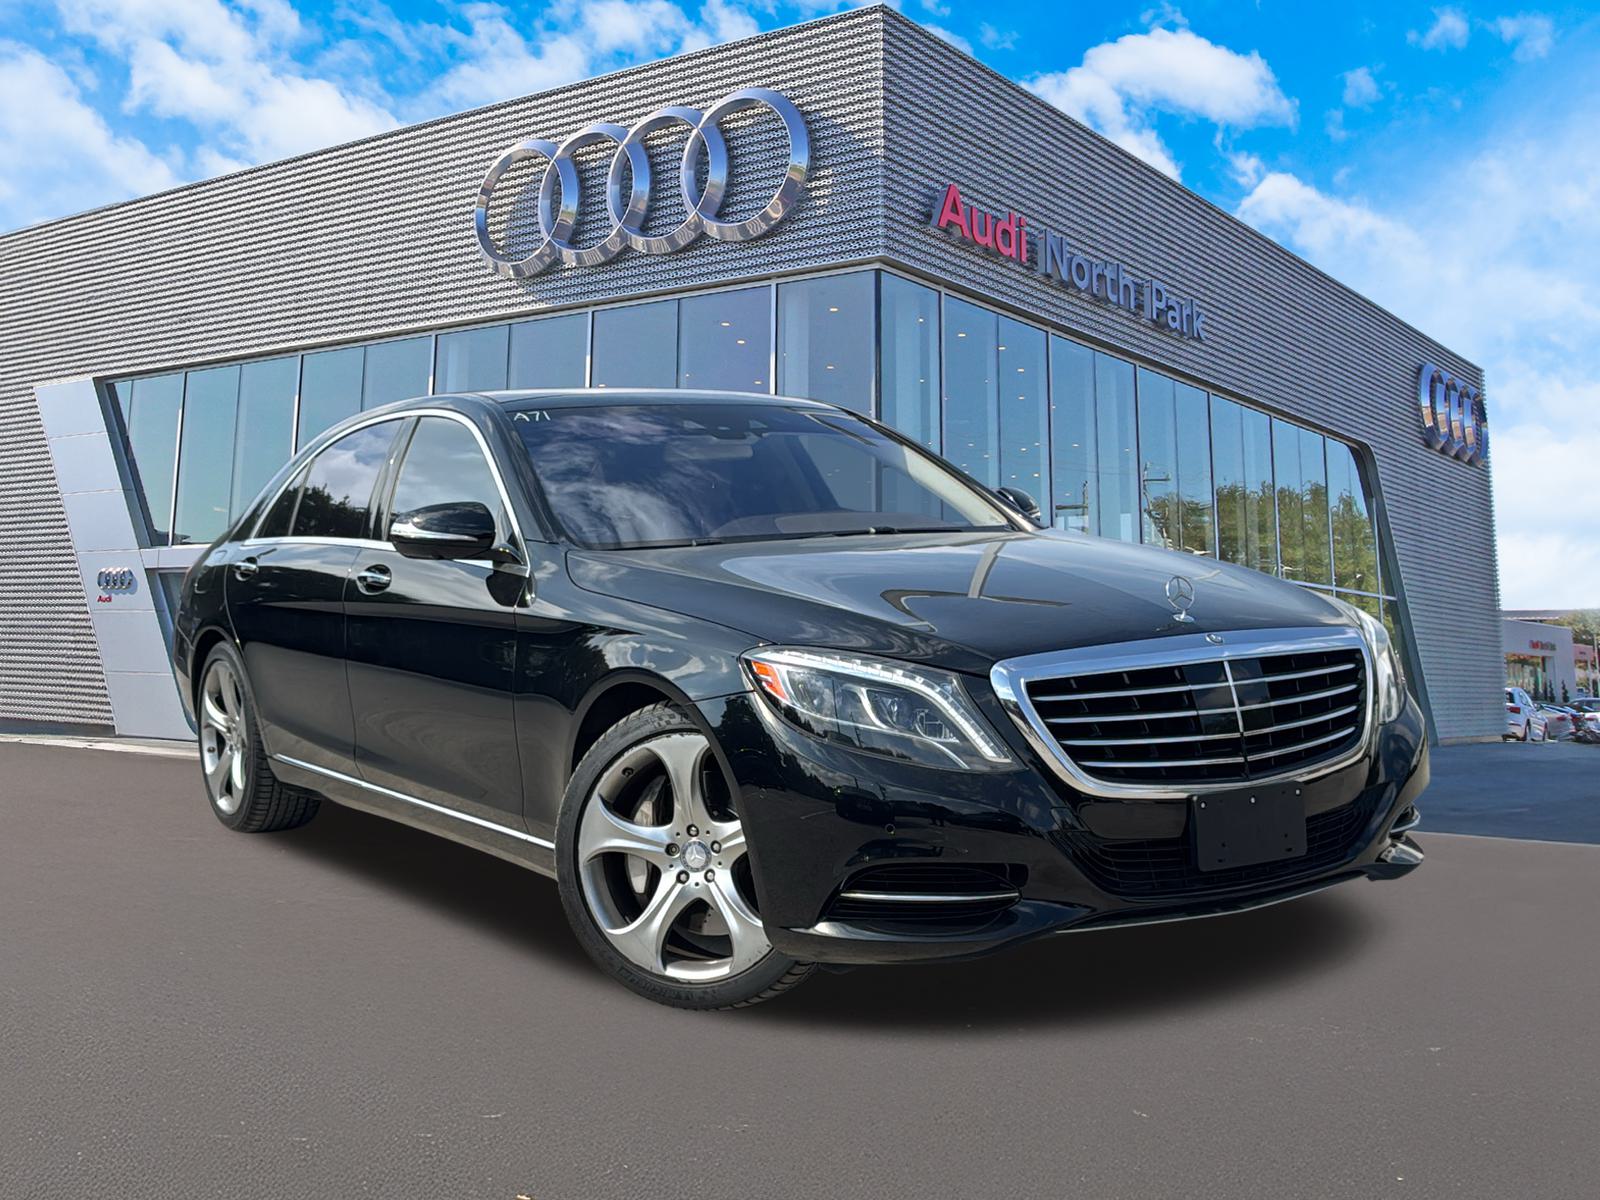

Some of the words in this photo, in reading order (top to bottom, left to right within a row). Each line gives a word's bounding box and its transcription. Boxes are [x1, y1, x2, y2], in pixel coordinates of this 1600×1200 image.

[933, 183, 1028, 263] Audi
[1037, 229, 1136, 310] North
[1145, 279, 1206, 341] Park
